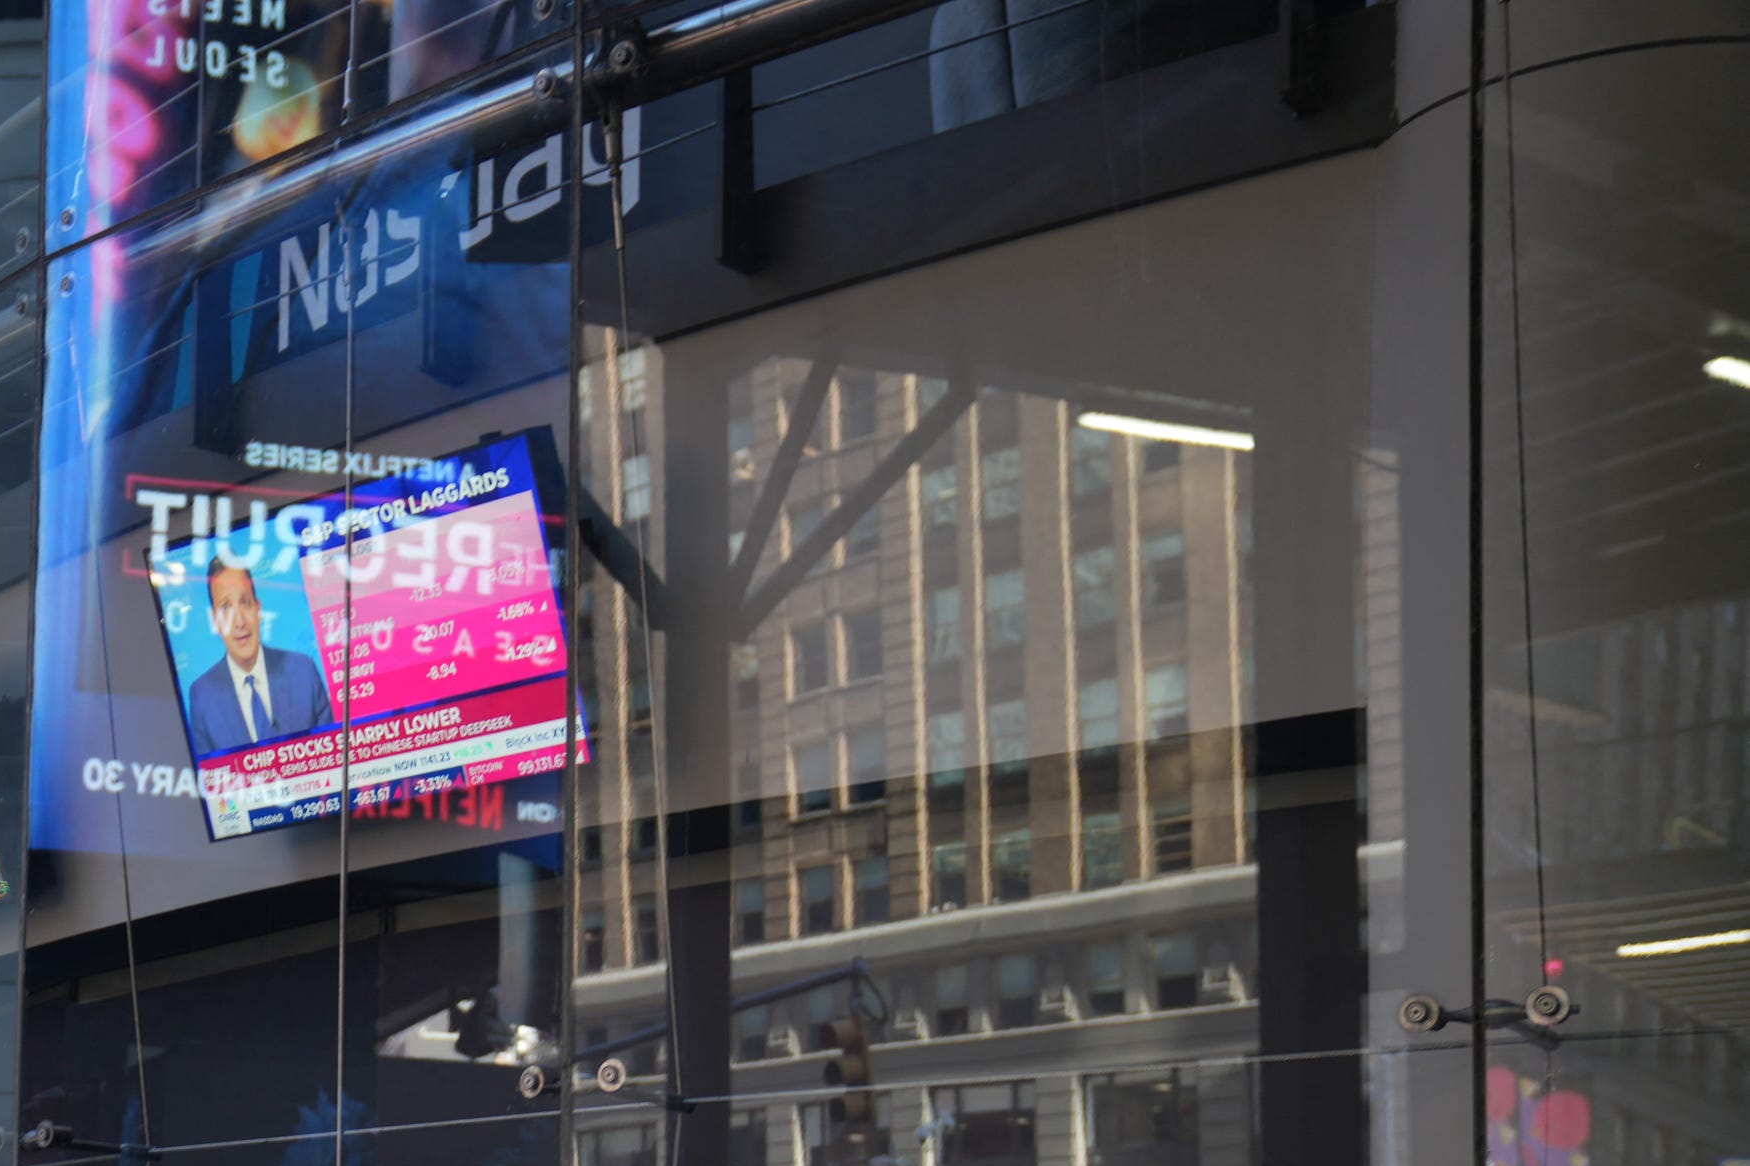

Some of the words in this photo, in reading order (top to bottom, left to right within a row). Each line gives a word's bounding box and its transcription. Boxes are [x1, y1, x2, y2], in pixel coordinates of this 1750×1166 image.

[334, 497, 406, 536] SECTOR
[407, 466, 510, 514] LAGGARDS
[334, 680, 376, 703] 65.29
[241, 748, 277, 771] CHIP
[276, 735, 334, 764] STOCKS
[334, 719, 402, 751] SHARPLY
[402, 705, 462, 735] LOWER
[307, 754, 335, 771] SLIDE
[357, 746, 371, 760] TO
[369, 736, 414, 757] CHINESE
[413, 726, 459, 747] STARTUP
[458, 713, 513, 737] DEEPSEEK
[289, 796, 341, 821] 19,290.63
